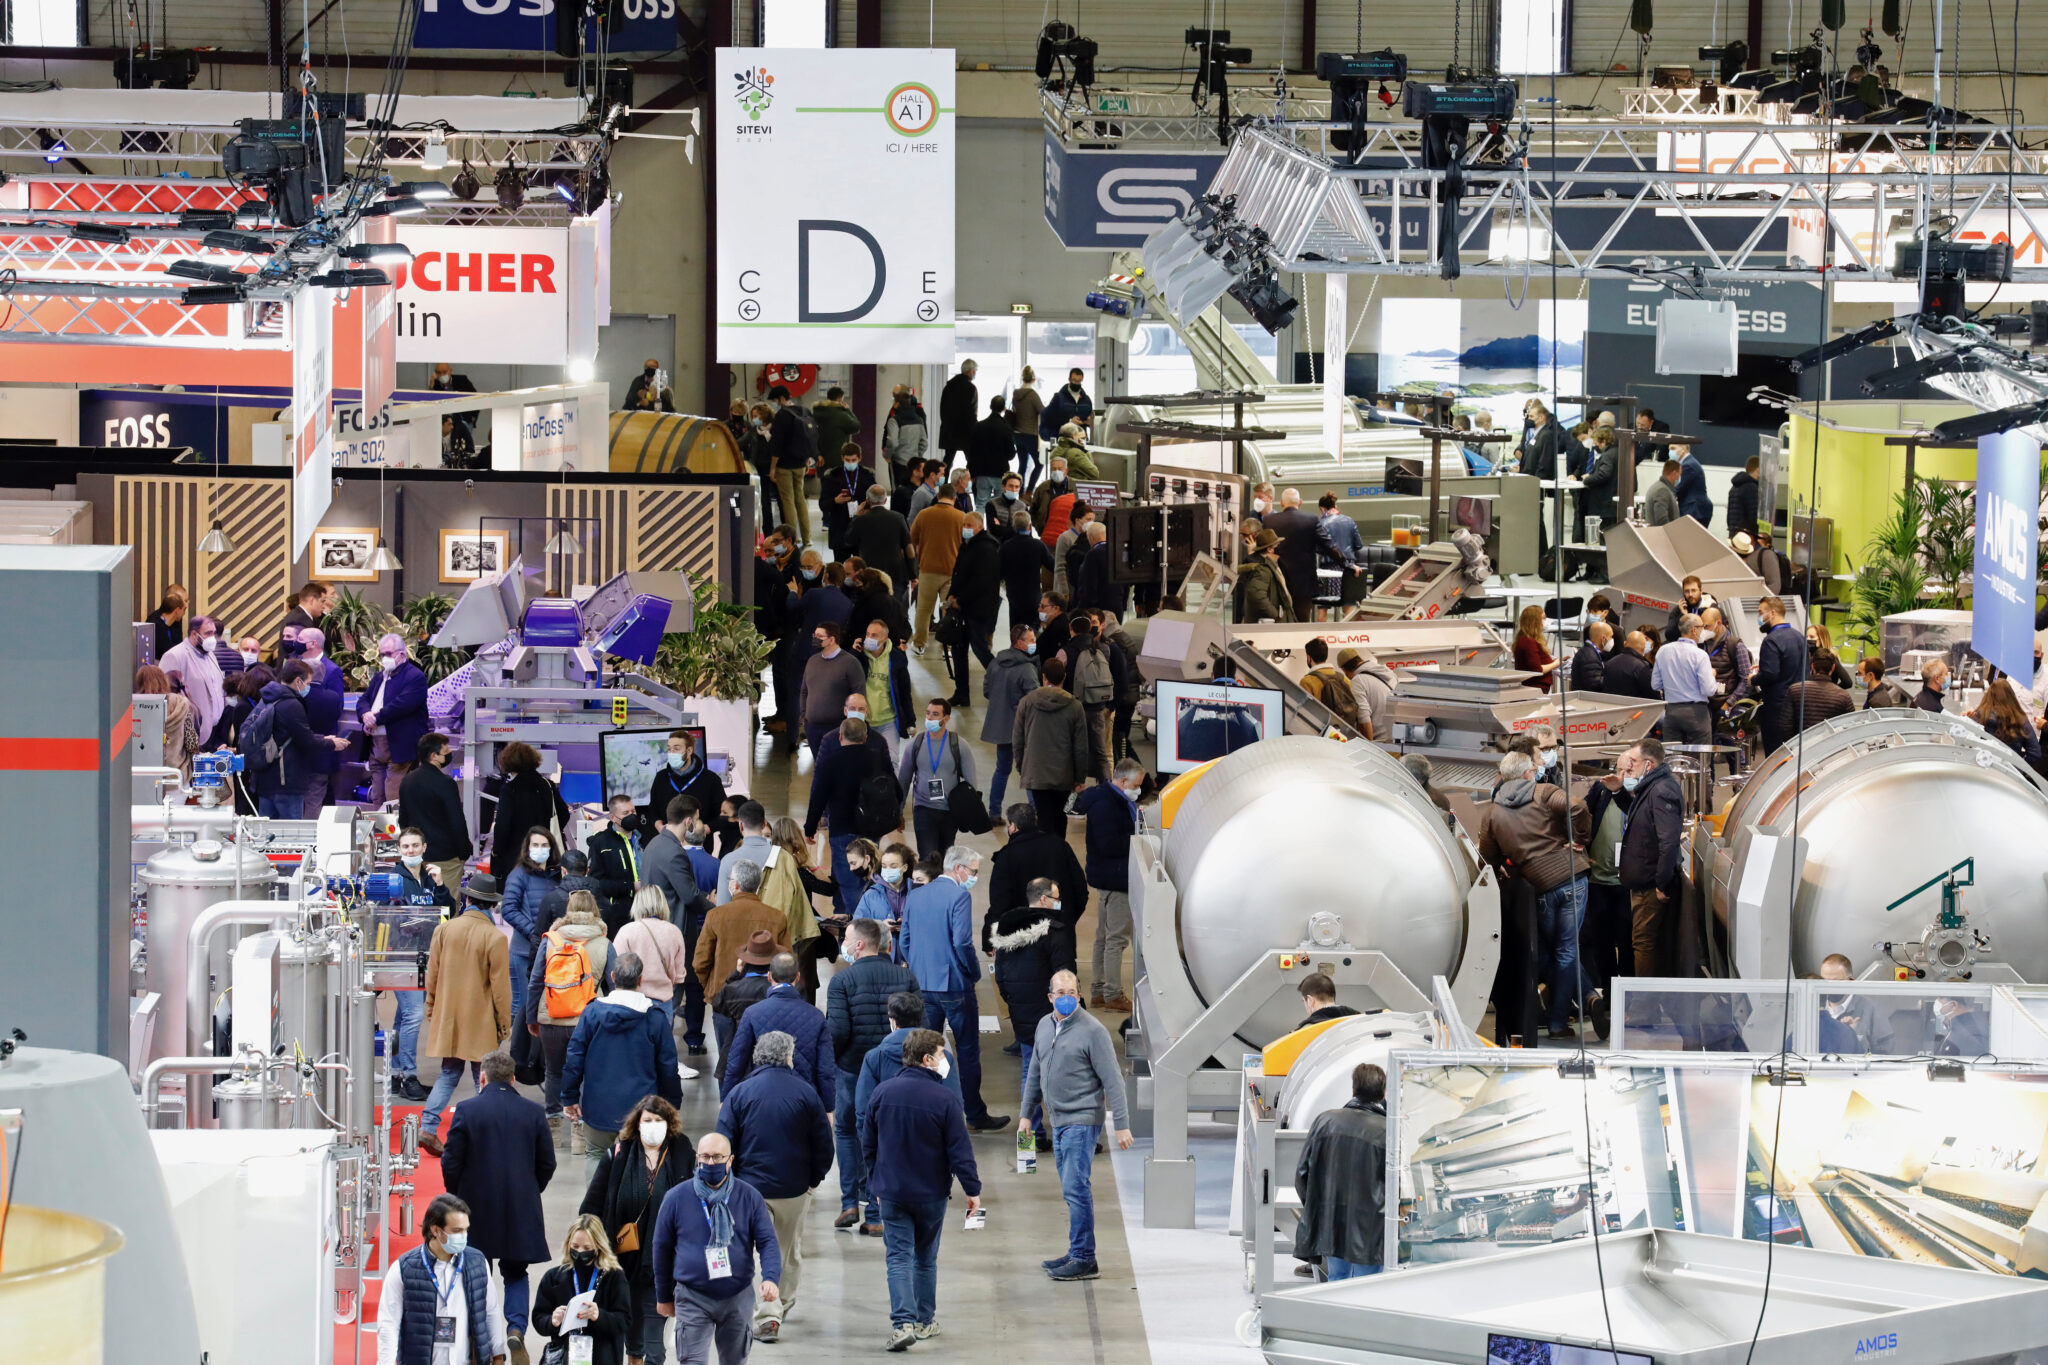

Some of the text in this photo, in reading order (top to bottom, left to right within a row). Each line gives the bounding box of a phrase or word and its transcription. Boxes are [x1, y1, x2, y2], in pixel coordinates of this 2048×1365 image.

[900, 95, 924, 103] HALL
[898, 105, 922, 121] A1
[736, 126, 772, 134] SITEVI
[886, 143, 938, 154] ICI / HERE
[799, 219, 887, 323] D
[739, 270, 761, 293] C
[922, 271, 936, 293] E
[105, 413, 171, 447] FOSS
[1983, 491, 2028, 581] AMOS
[1627, 594, 1669, 611] SOCMA
[1559, 722, 1607, 735] SOCMA
[1855, 1333, 1898, 1355] AMOS
